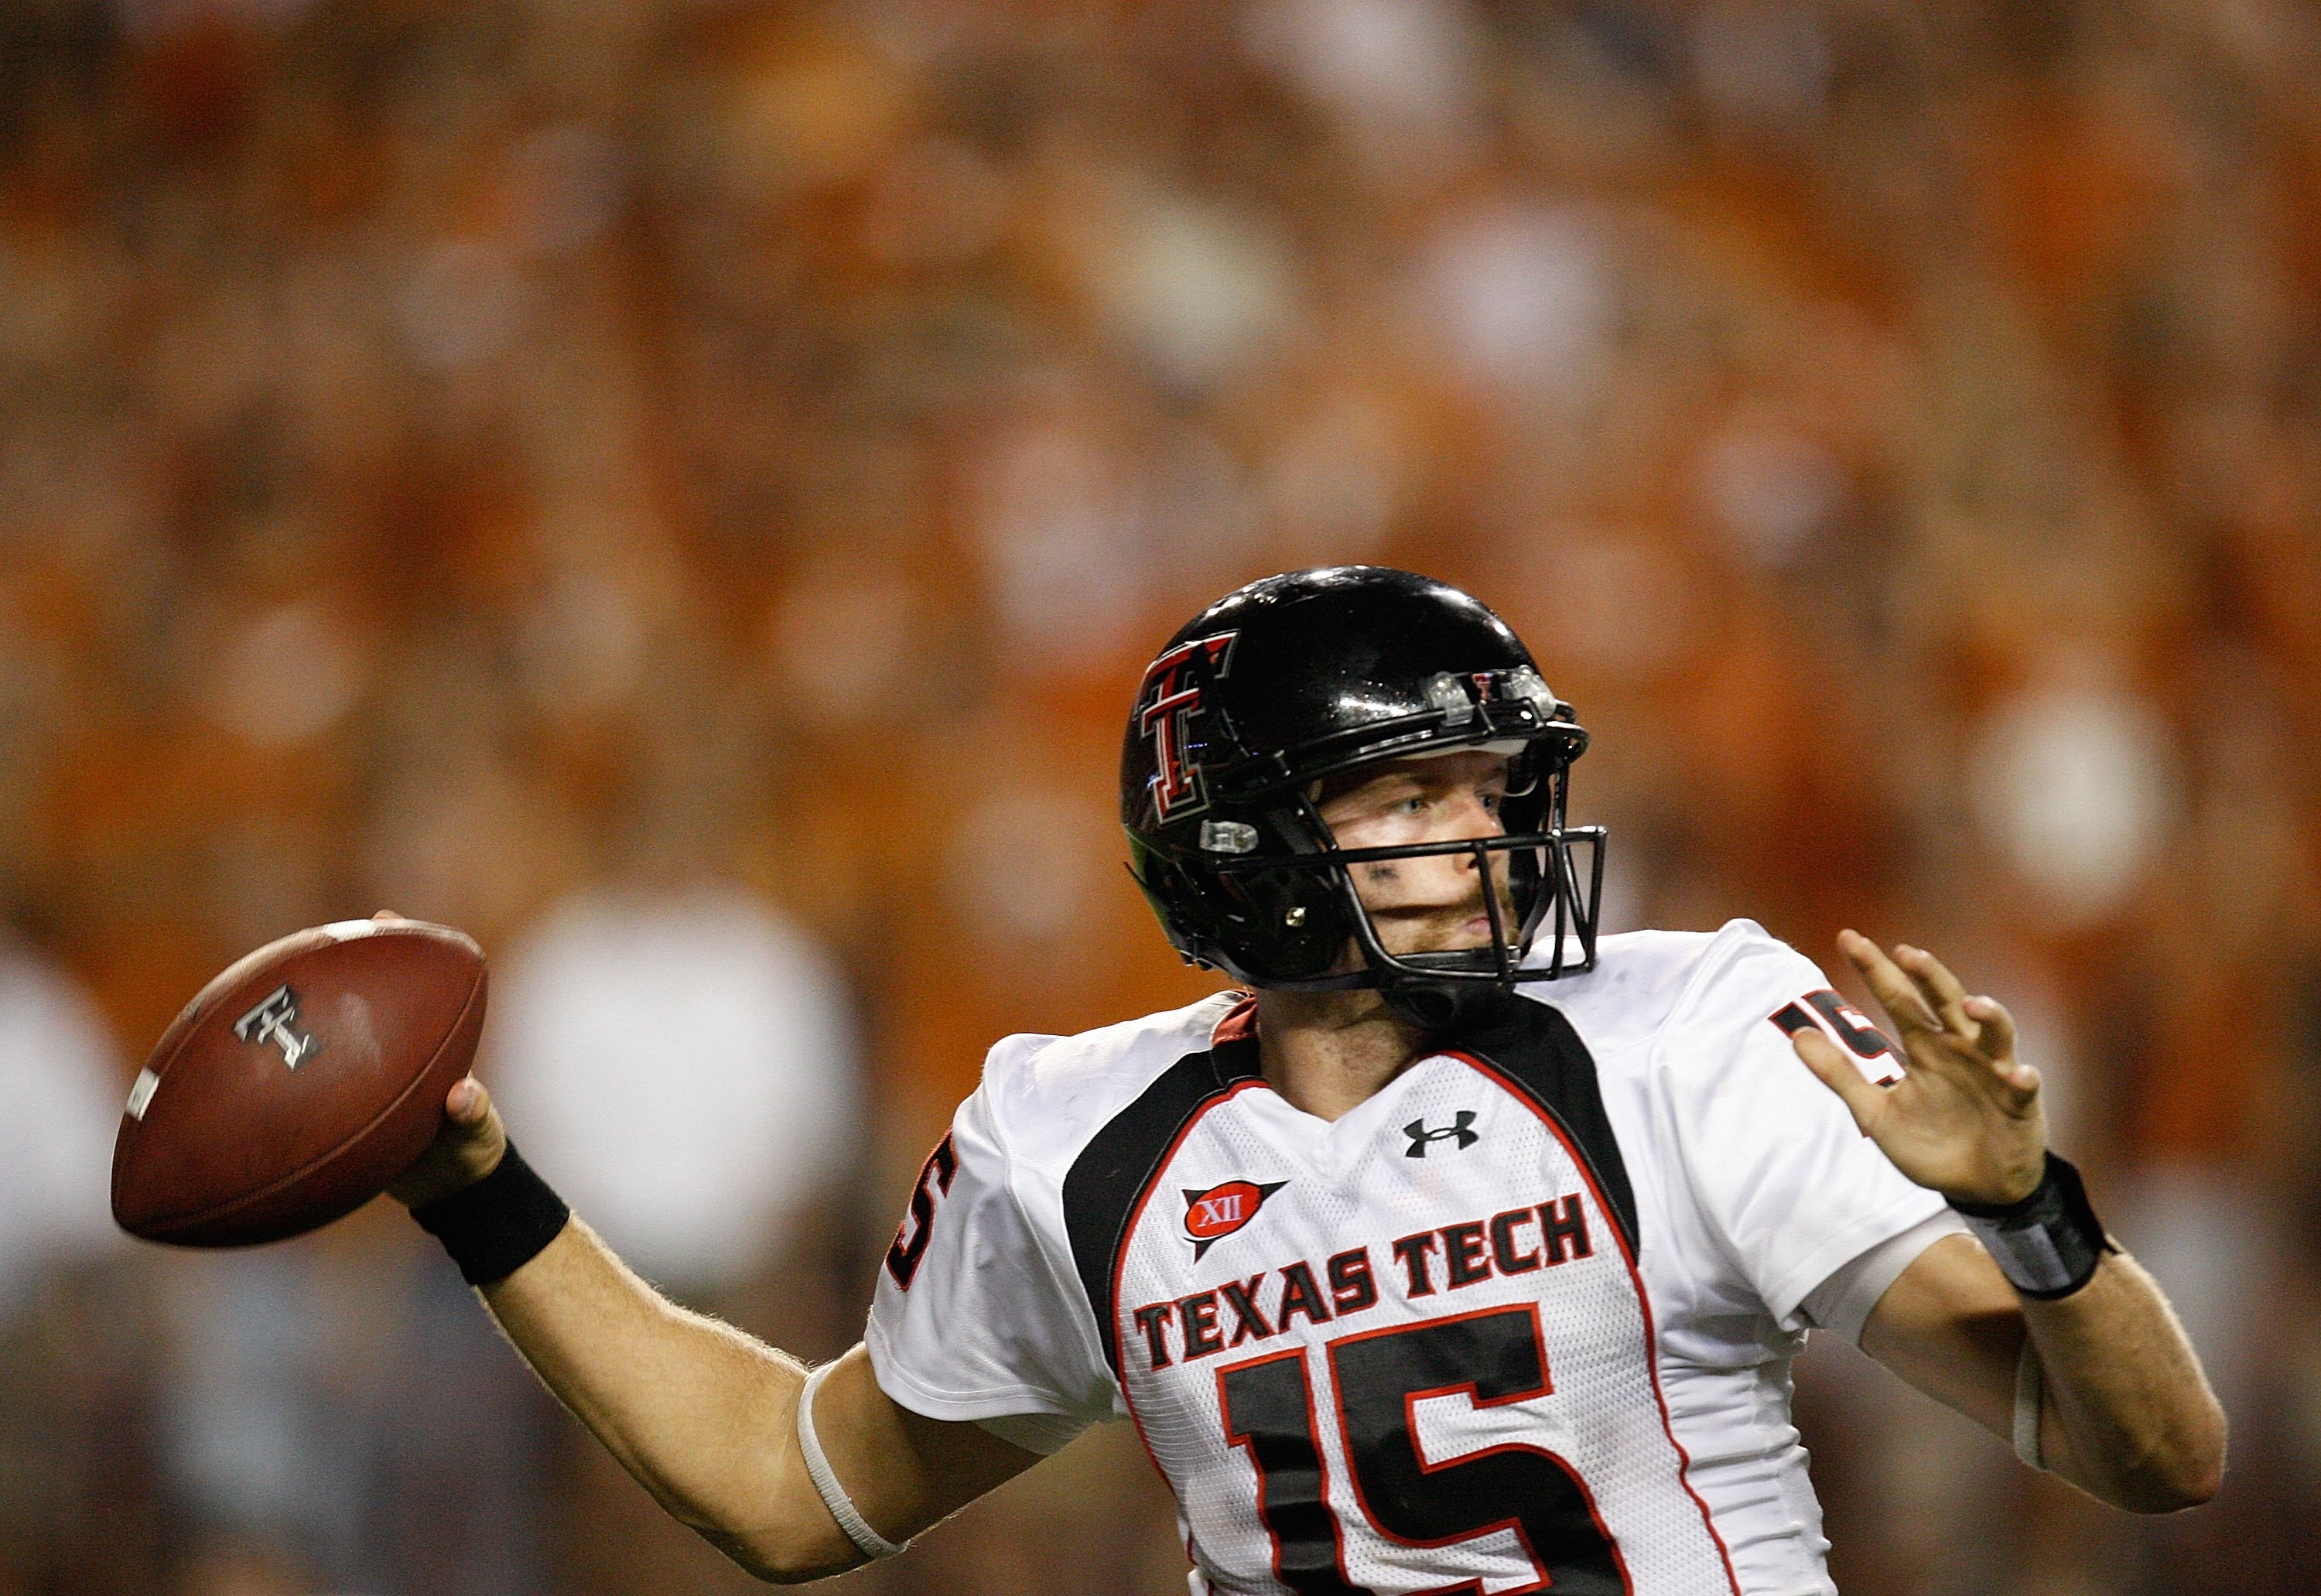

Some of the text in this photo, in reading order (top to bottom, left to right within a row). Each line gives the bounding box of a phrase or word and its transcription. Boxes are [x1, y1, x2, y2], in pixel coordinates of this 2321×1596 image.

[1133, 1193, 1595, 1372] TEXAS TECH
[1196, 1194, 1243, 1227] XII
[1215, 1302, 1635, 1596] 15
